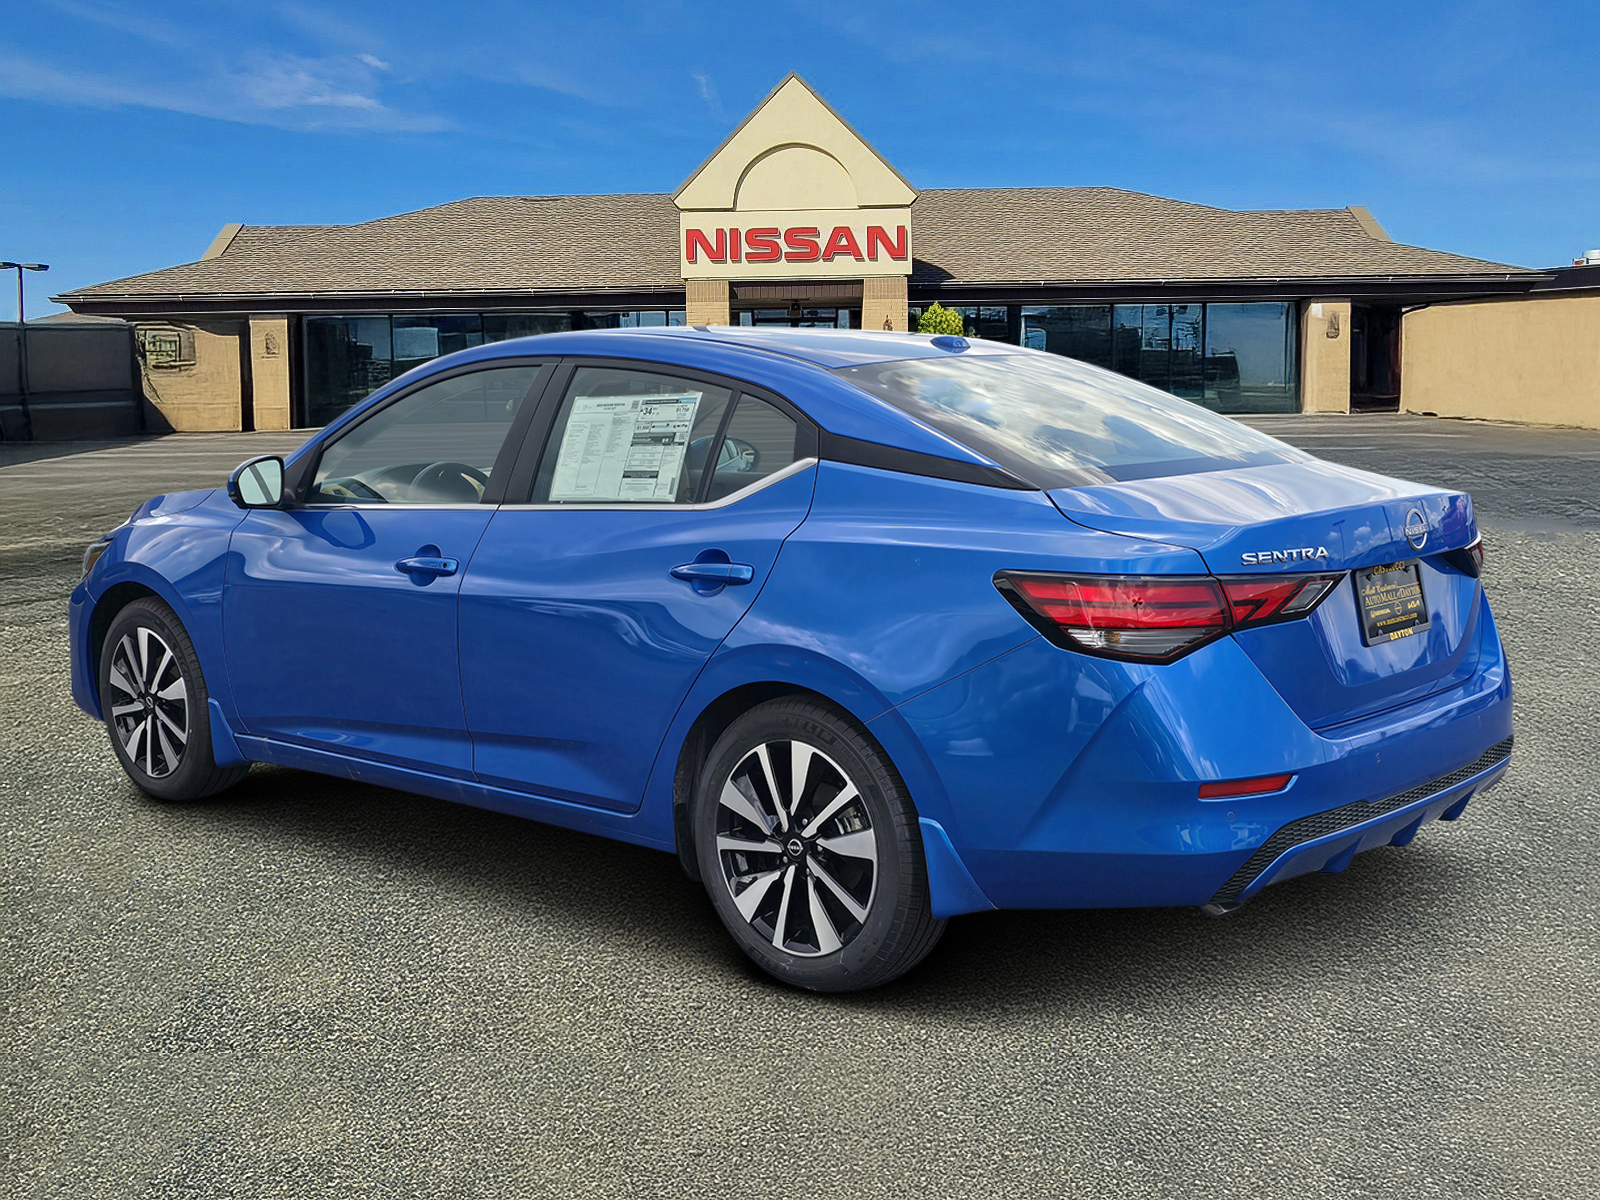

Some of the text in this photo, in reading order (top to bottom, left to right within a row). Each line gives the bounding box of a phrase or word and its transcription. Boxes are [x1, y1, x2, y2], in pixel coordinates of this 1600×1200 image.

[686, 225, 908, 264] NISSAN
[1241, 547, 1329, 565] SENTRA
[1389, 627, 1414, 640] DAYTON
